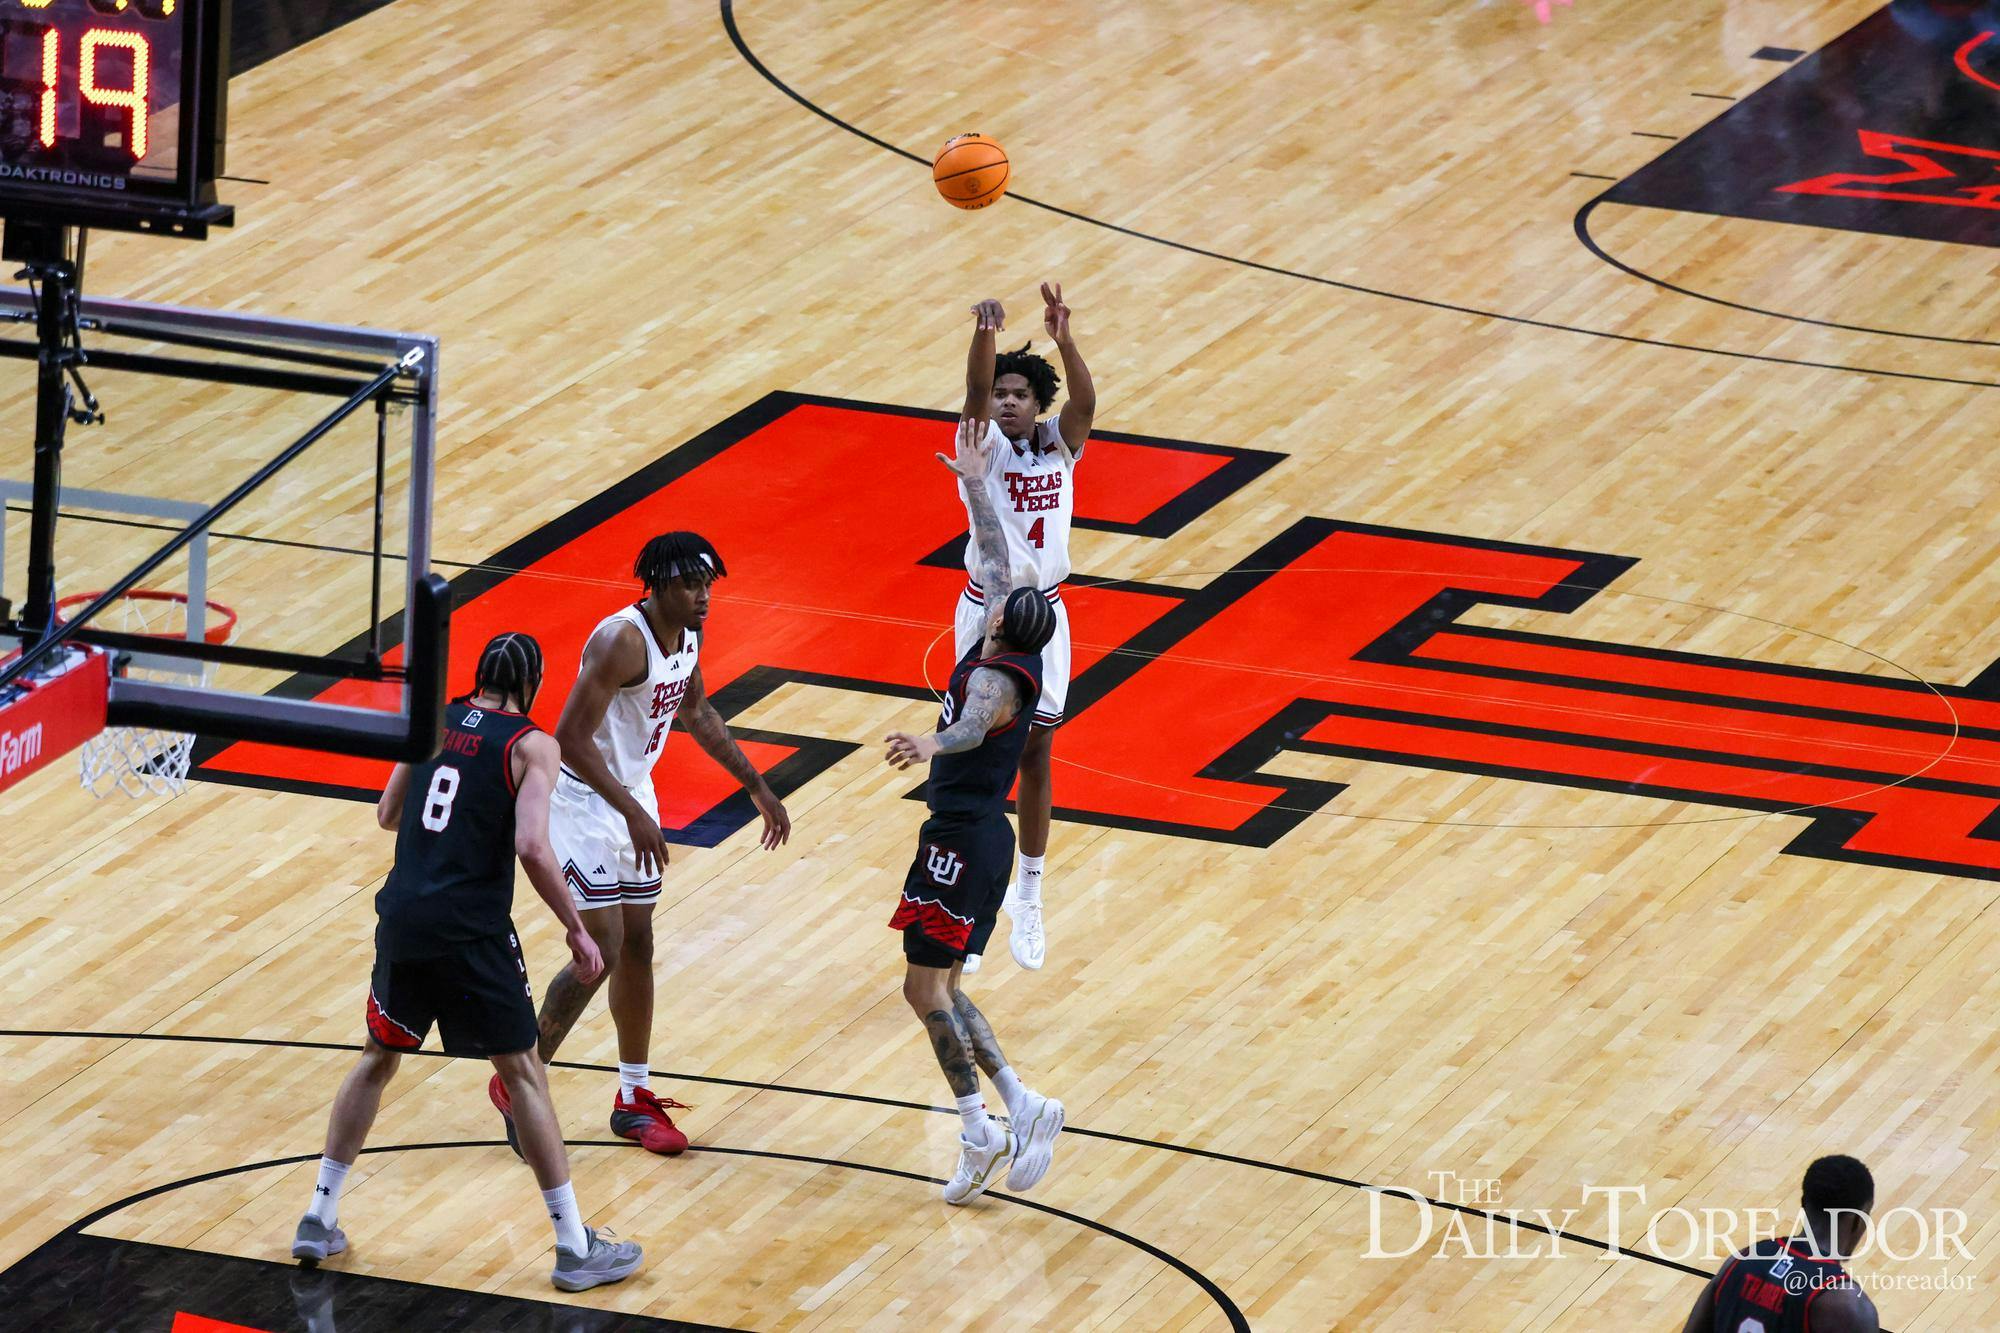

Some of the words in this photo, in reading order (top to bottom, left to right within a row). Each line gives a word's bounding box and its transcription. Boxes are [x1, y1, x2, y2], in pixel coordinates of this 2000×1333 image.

[40, 27, 150, 160] 19
[0, 165, 126, 190] DAKTRONICS
[1004, 472, 1062, 493] TEXAS
[1011, 491, 1059, 512] TECH
[1028, 517, 1044, 548] 4
[653, 676, 690, 702] TEXAS
[0, 722, 43, 778] Farm
[422, 765, 460, 832] 8
